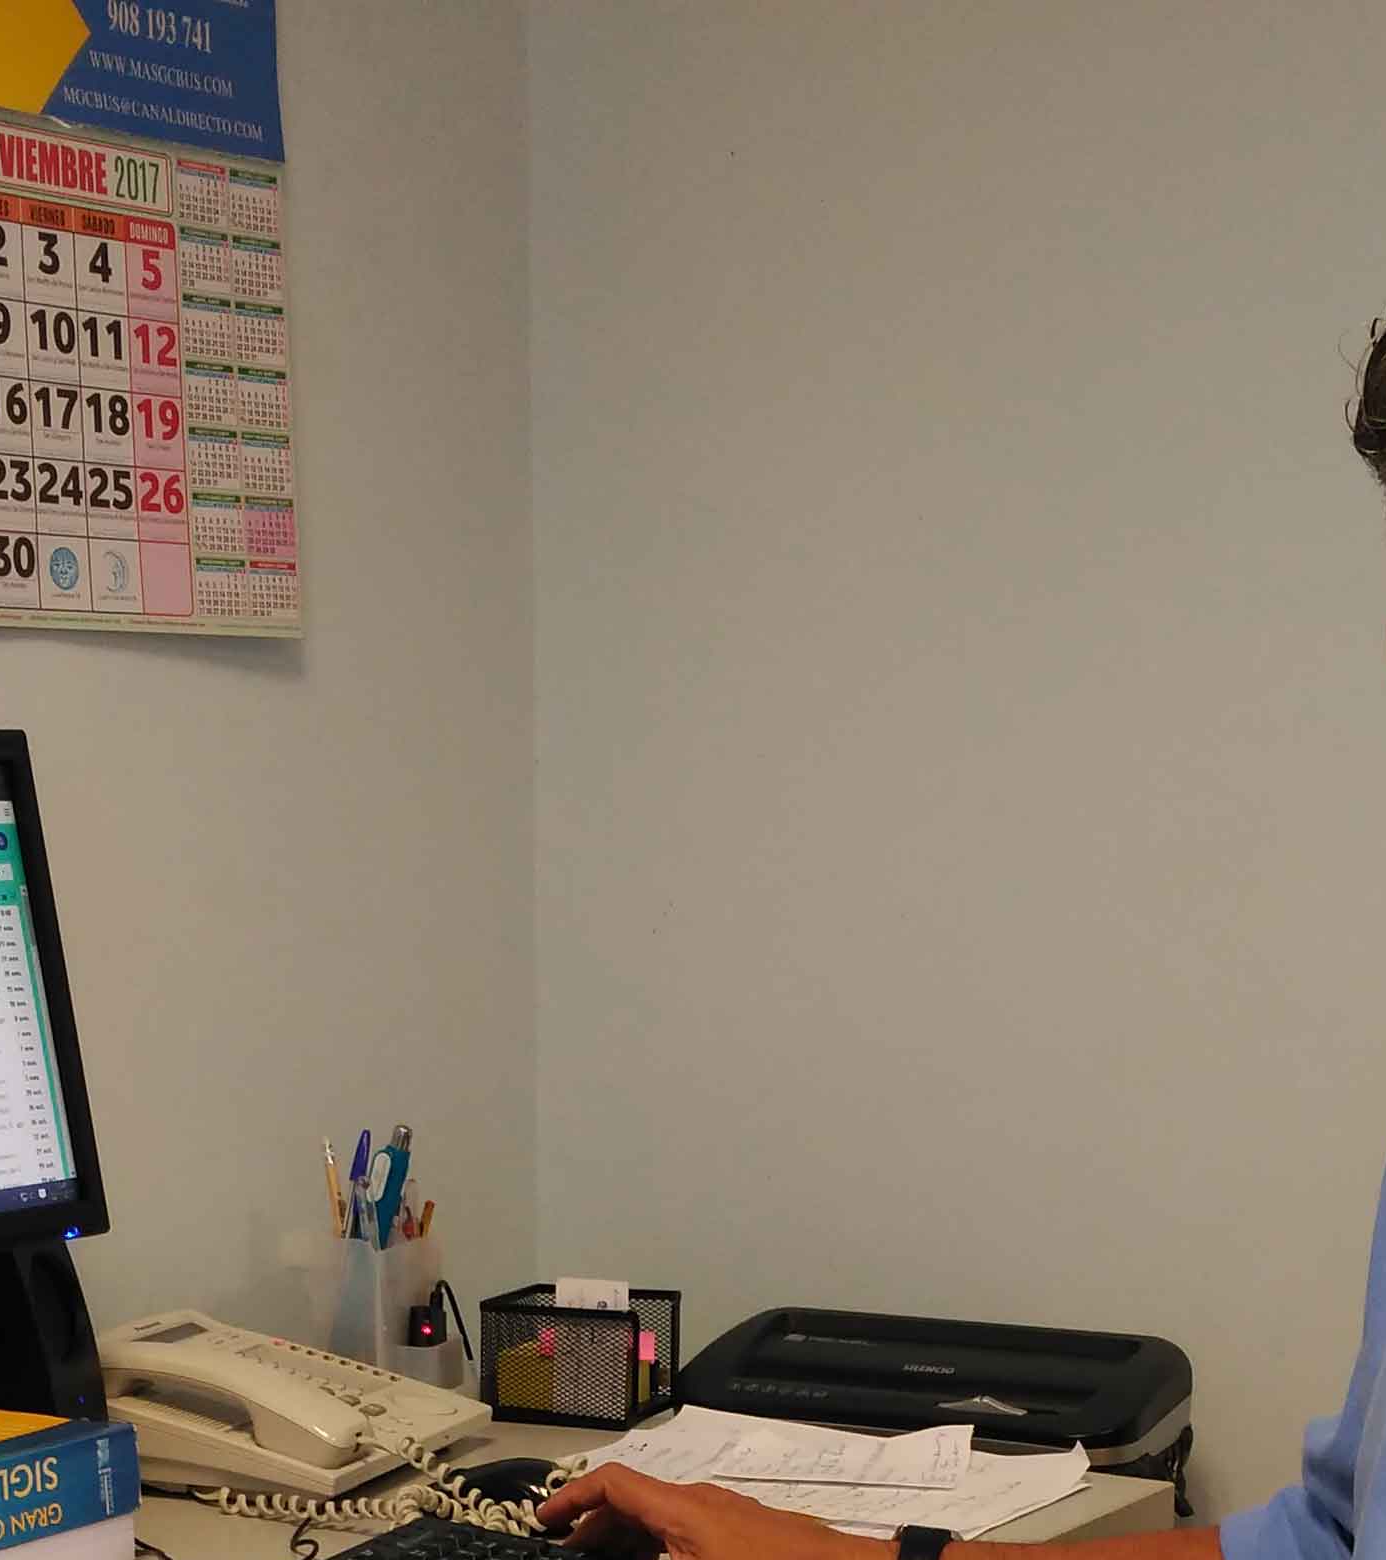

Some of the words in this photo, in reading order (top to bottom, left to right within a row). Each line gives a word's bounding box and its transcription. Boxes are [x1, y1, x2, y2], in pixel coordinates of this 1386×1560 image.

[107, 0, 141, 37] 908
[146, 8, 177, 45] 193
[181, 16, 213, 54] 741
[114, 156, 160, 204] 2017
[30, 204, 66, 226] VIERNES
[129, 220, 169, 245] DOMINGO
[38, 231, 61, 276] 3
[89, 241, 113, 284] 4
[141, 249, 163, 292] 5
[30, 309, 76, 354] 10
[82, 316, 123, 361] 11
[133, 323, 178, 368] 12
[34, 386, 79, 430] 17
[85, 392, 130, 436] 18
[136, 398, 180, 441] 19
[37, 462, 83, 506] 24
[88, 467, 133, 511] 25
[139, 471, 184, 514] 26
[10, 1503, 63, 1538] GRAN
